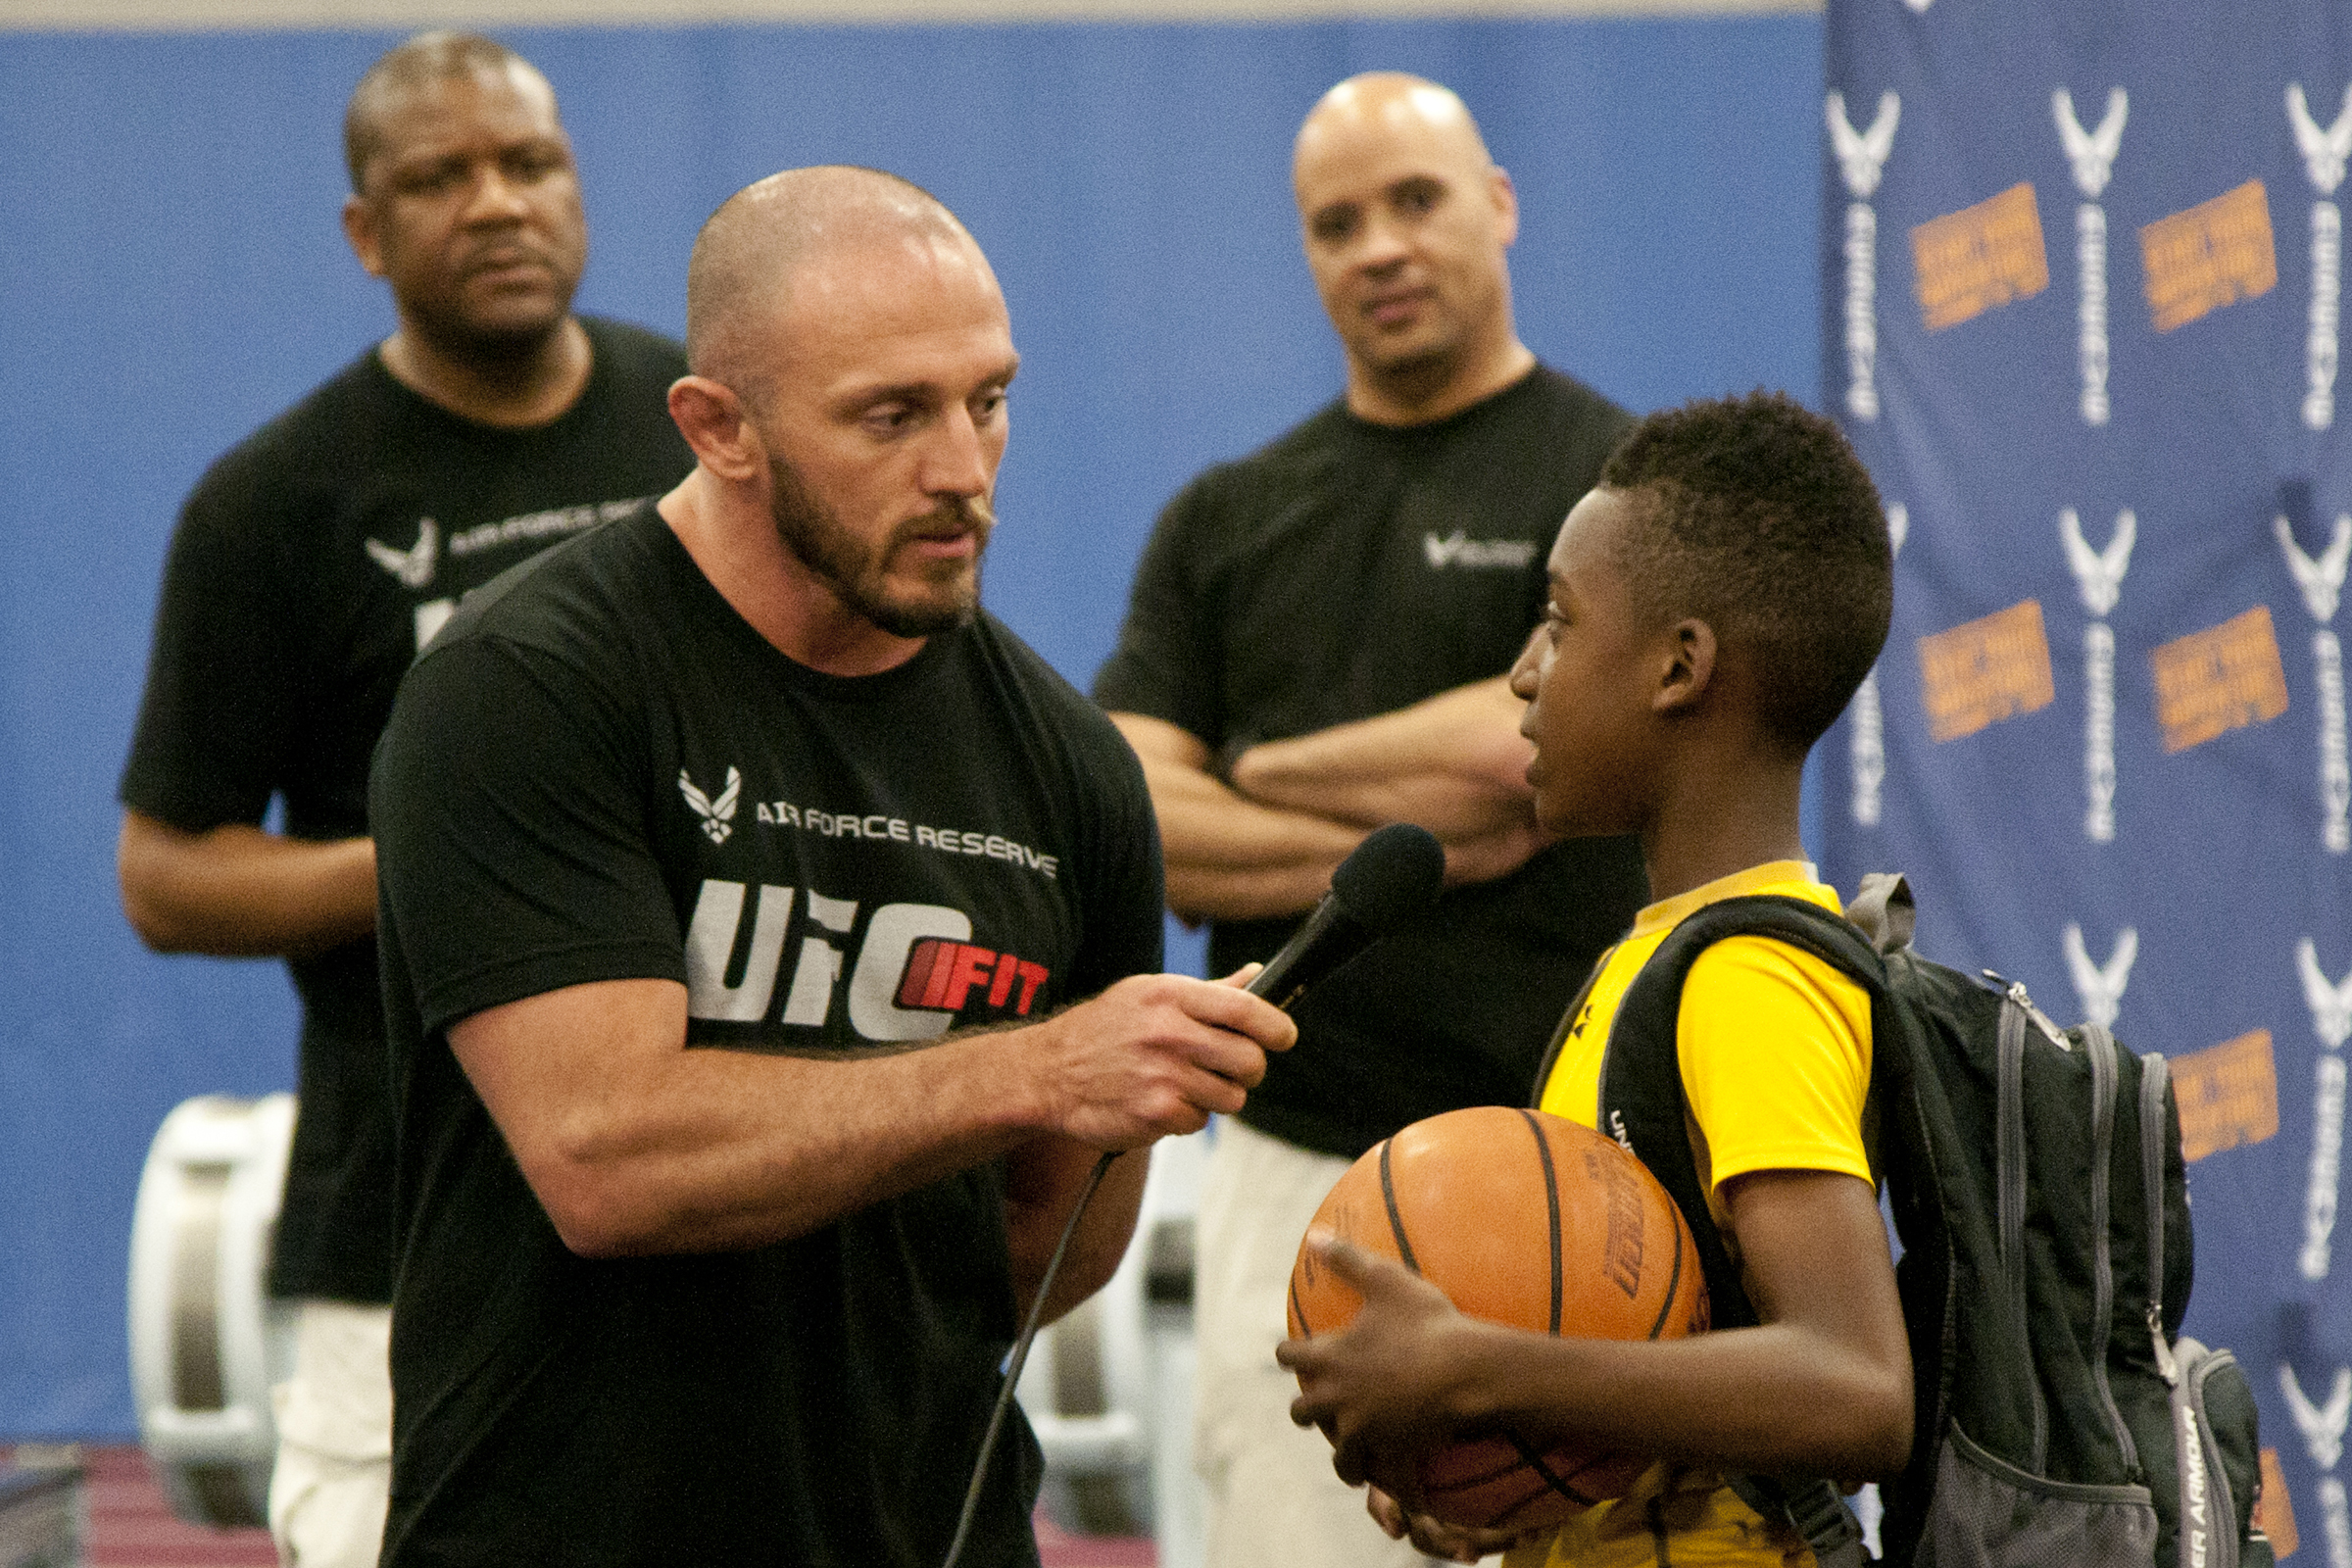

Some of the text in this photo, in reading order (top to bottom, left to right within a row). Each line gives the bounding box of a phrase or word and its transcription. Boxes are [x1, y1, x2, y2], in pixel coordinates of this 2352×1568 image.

[757, 801, 1058, 879] AIR FORCE RESERVE
[943, 945, 1049, 1015] FIT
[2182, 1404, 2206, 1526] ARMOUR
